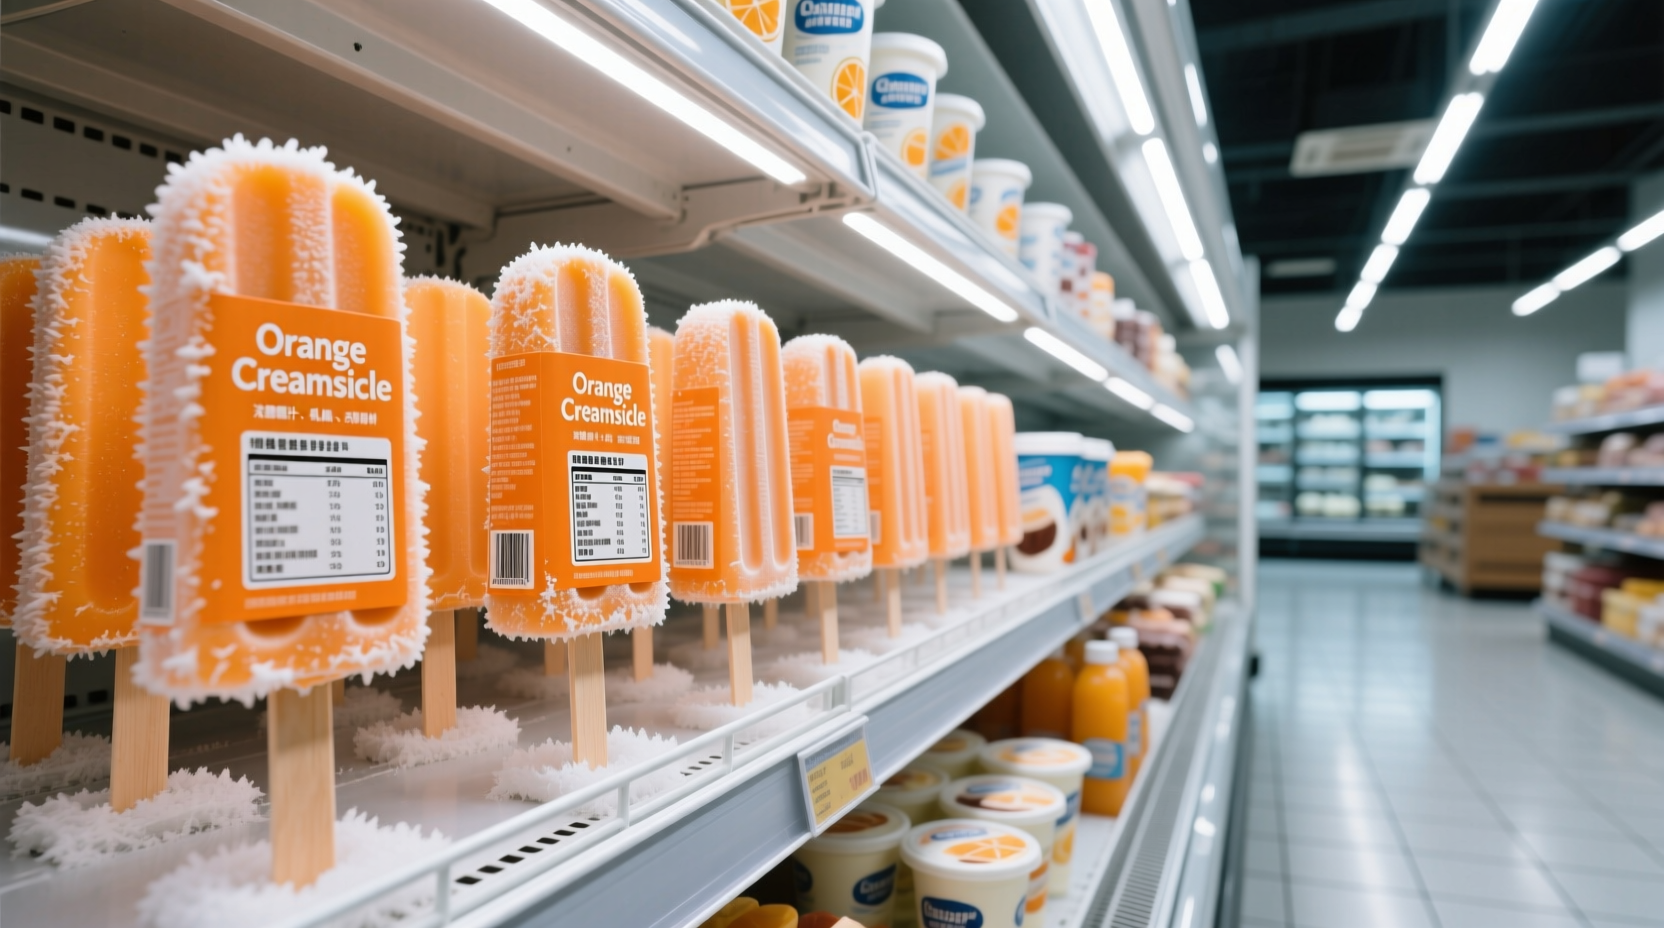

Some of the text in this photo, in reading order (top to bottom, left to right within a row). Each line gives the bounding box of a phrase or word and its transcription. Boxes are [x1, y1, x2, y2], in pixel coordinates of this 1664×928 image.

[255, 322, 367, 371] Orange
[231, 356, 392, 402] Creamsicle
[572, 371, 632, 406] Orange
[560, 397, 646, 427] Creamsicle
